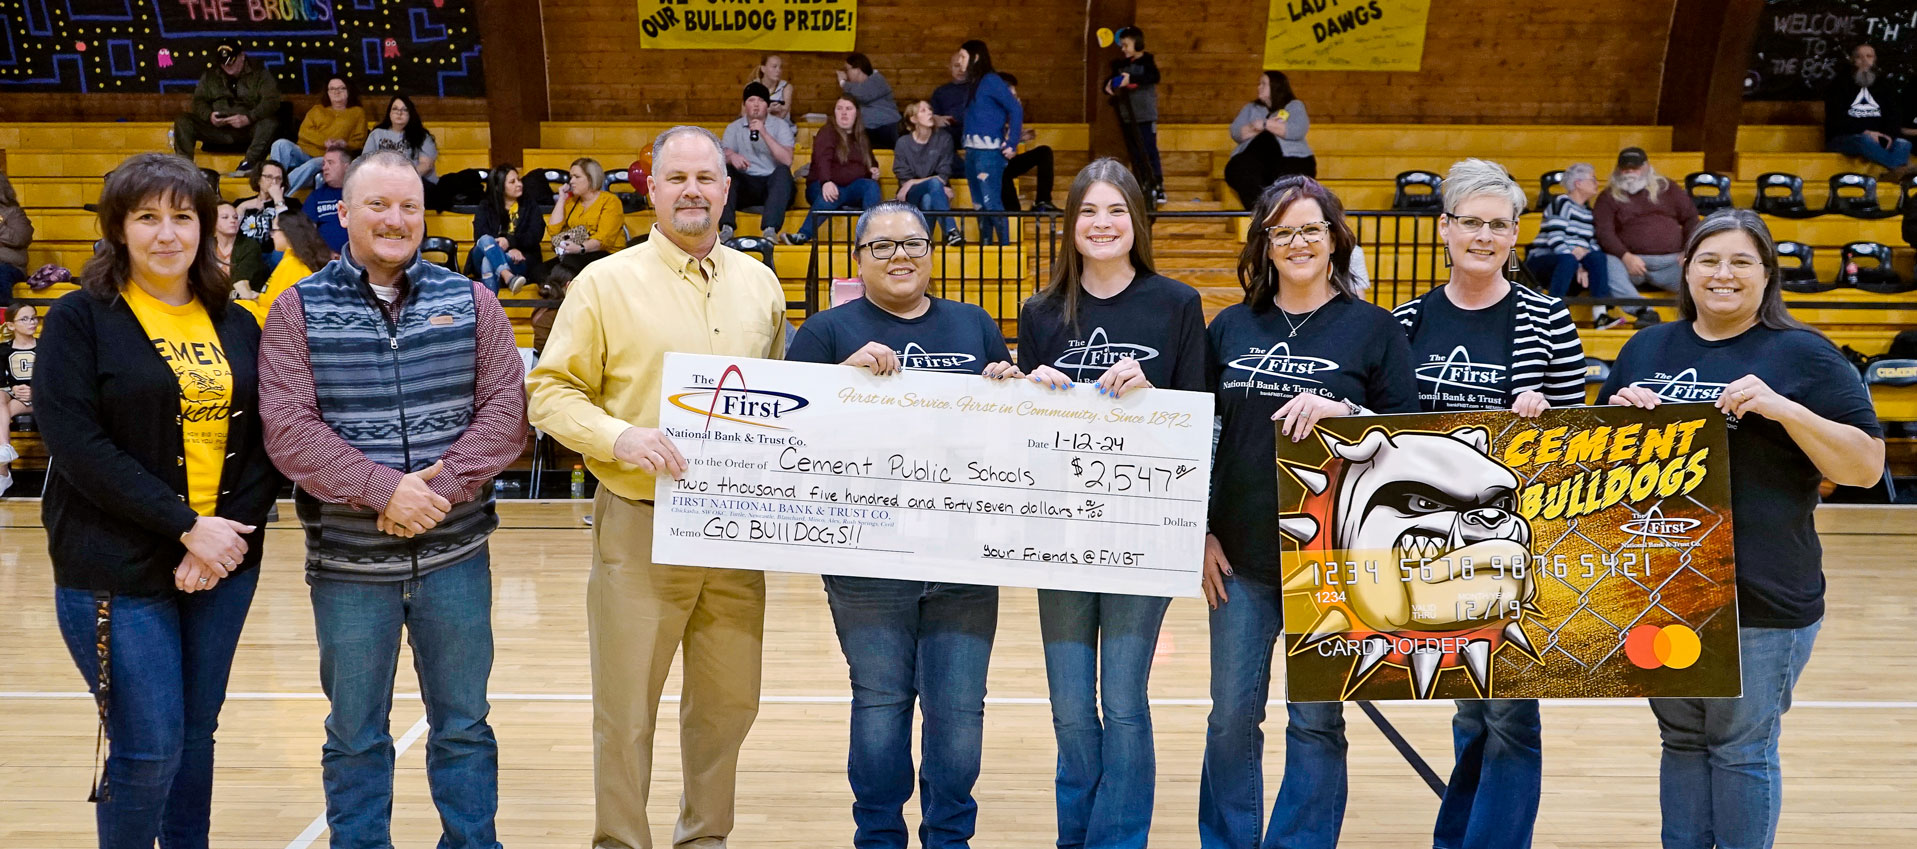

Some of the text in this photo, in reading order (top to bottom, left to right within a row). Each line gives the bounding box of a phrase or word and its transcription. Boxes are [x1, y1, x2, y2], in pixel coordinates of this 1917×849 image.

[179, 0, 238, 21] THE
[641, 6, 853, 38] OUR BULLDOG PRIDE!
[1312, 0, 1383, 43] DAWGS
[1774, 12, 1863, 36] WELCOME
[1802, 37, 1827, 55] TO
[151, 338, 228, 365] EMEN
[911, 356, 961, 368] First
[1266, 358, 1316, 374] First
[692, 374, 714, 384] The
[1448, 366, 1499, 384] First
[1654, 372, 1673, 380] The
[1223, 380, 1335, 398] National Bank & Trust Co.
[1418, 392, 1502, 404] ional Bank & Trust
[1669, 384, 1722, 399] First
[722, 395, 781, 418] First
[838, 387, 1193, 428] First in Service. First in Community. Since 1892.
[665, 427, 806, 446] National Bank & Trust Co.
[1027, 439, 1049, 449] Date
[1055, 431, 1124, 451] 1-12-24
[1503, 418, 1707, 468] CEMENT
[707, 458, 722, 467] the
[725, 458, 753, 469] Order
[757, 461, 768, 470] of
[779, 446, 1036, 487] Cement Public Schools
[1520, 447, 1709, 520] BULLDOGS
[717, 476, 796, 499] thousand
[845, 488, 899, 506] hundred
[908, 497, 935, 510] and
[1020, 501, 1073, 518] dollars
[672, 496, 891, 520] FIRST NATIONAL BANK & TRUST CO.
[703, 517, 739, 539] GO
[1163, 516, 1197, 528] Dollars
[1650, 522, 1686, 533] First
[669, 528, 700, 539] Memo
[1023, 547, 1078, 564] Friends
[1083, 549, 1096, 564] @
[1099, 550, 1144, 566] FNBT
[1313, 553, 1650, 586] 1234 5678 9876 5421
[1315, 591, 1346, 603] 1234
[1412, 604, 1437, 612] VALID
[1412, 611, 1437, 619] THRU
[1456, 600, 1521, 622] 12/19
[1317, 637, 1471, 658] CARD HOLDER
